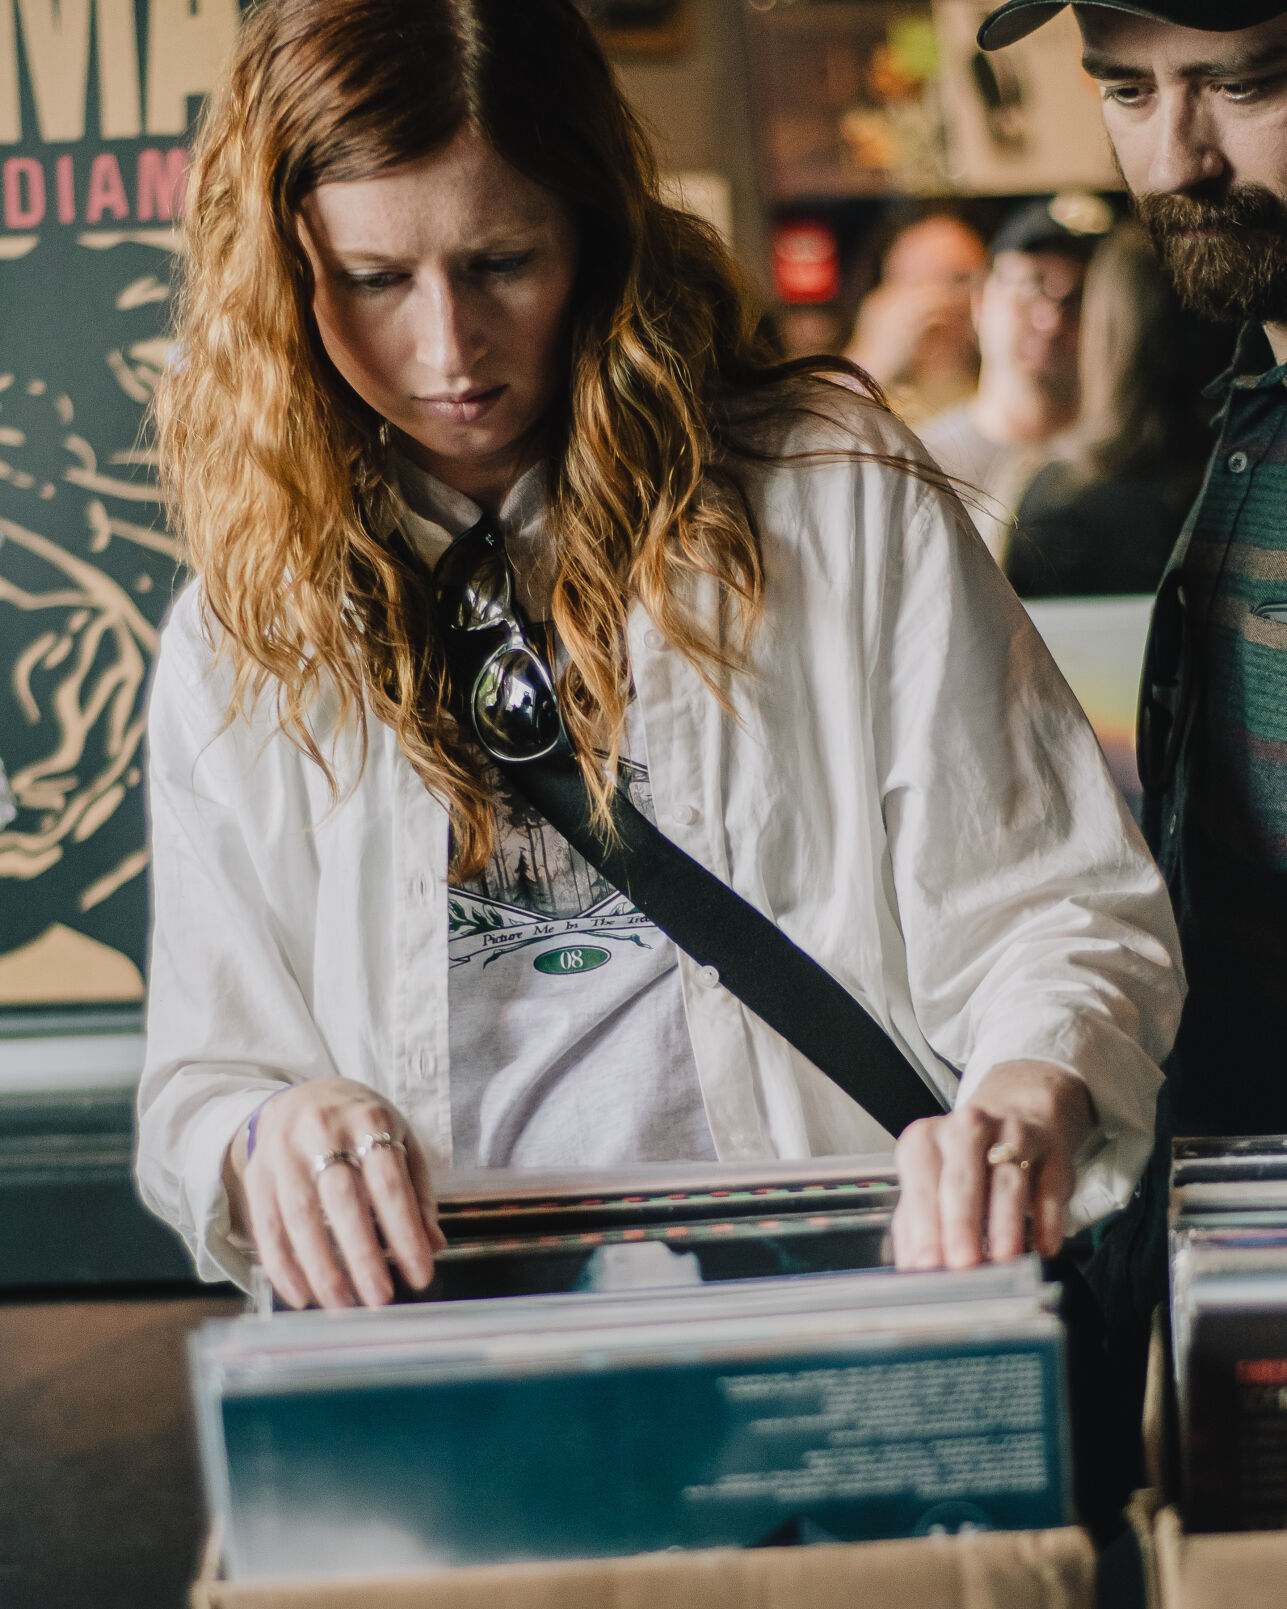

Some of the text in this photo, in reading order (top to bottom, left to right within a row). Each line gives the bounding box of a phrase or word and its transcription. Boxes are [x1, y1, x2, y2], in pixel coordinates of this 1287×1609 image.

[482, 932, 523, 946] Picture
[533, 924, 554, 935] Me
[565, 921, 578, 930] In
[590, 918, 616, 927] The
[559, 949, 584, 970] 08
